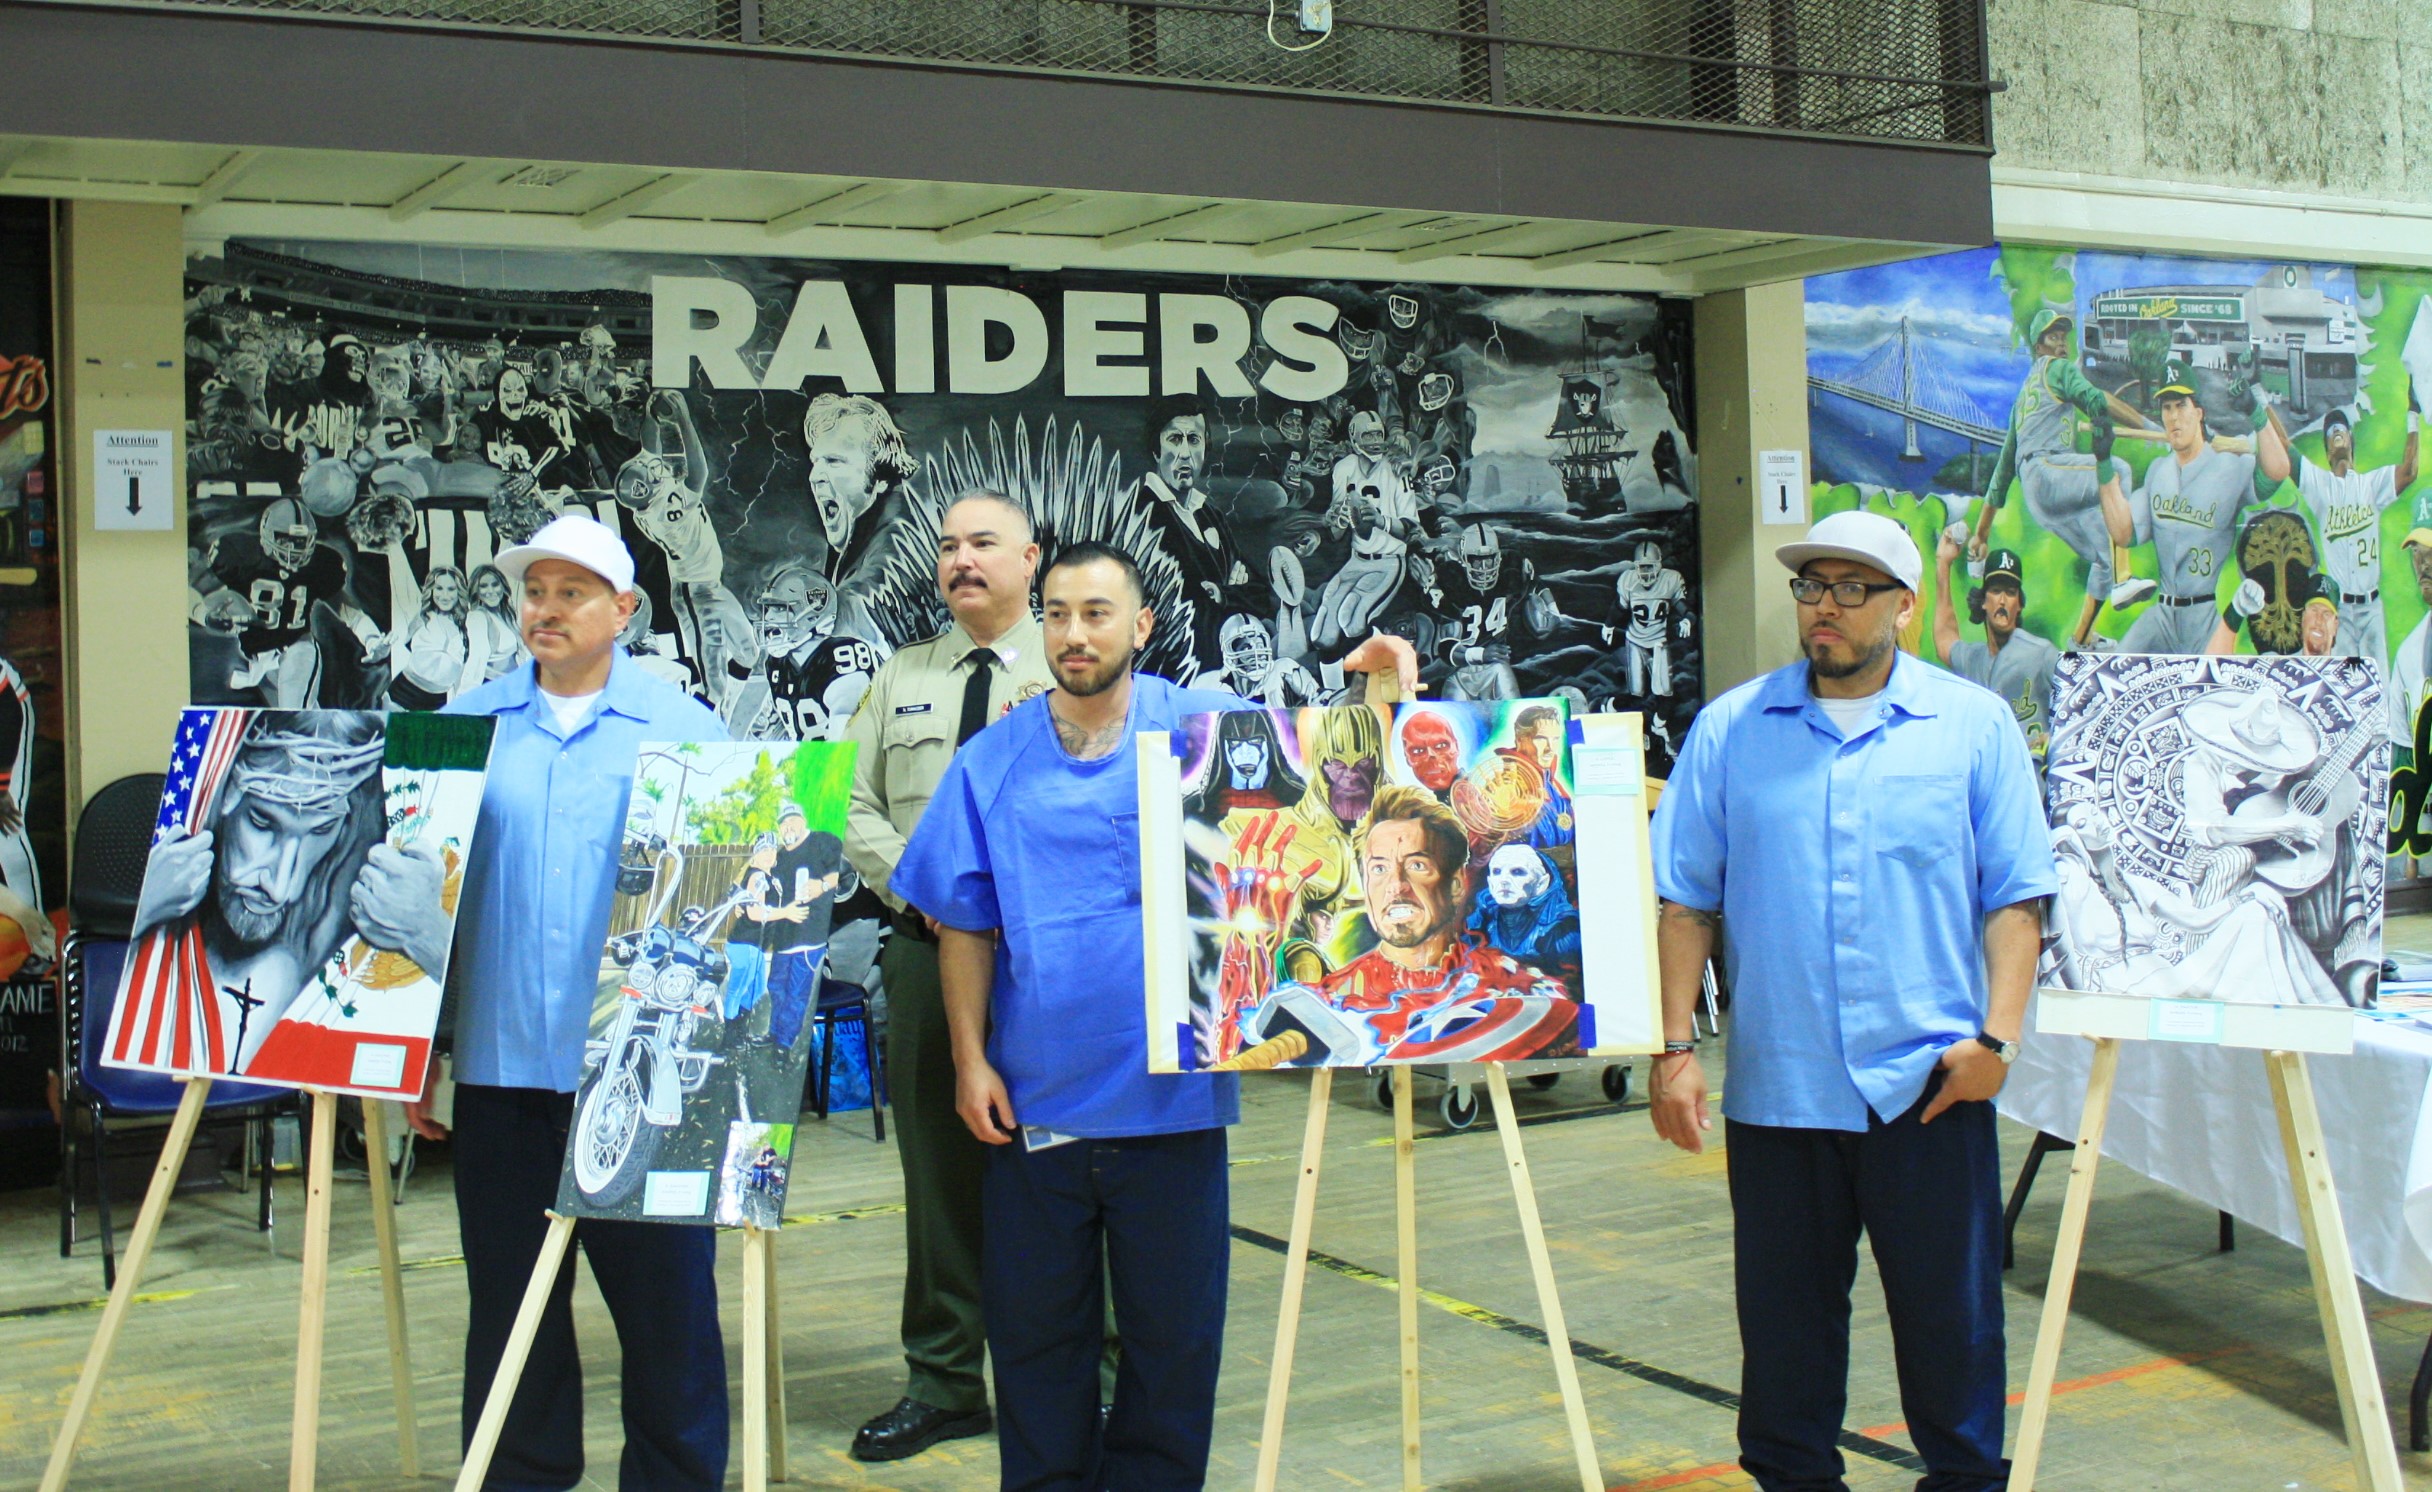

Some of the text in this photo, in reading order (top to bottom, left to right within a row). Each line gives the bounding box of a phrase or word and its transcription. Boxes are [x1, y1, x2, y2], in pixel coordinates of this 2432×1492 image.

[2101, 296, 2232, 318] ROOTED IN Oakland SINCE '68
[651, 274, 1349, 402] RAIDERS
[108, 435, 159, 447] Attention
[107, 458, 159, 466] Stack Chairs
[123, 468, 143, 476] Here
[1768, 455, 1795, 463] Attention
[2153, 493, 2217, 523] Oakland
[2324, 503, 2374, 534] Athletics
[2188, 547, 2212, 577] 33
[2357, 537, 2377, 567] 24
[250, 578, 308, 631] 81
[1631, 599, 1671, 628] 24
[1461, 597, 1509, 646] 34
[833, 642, 872, 675] 98
